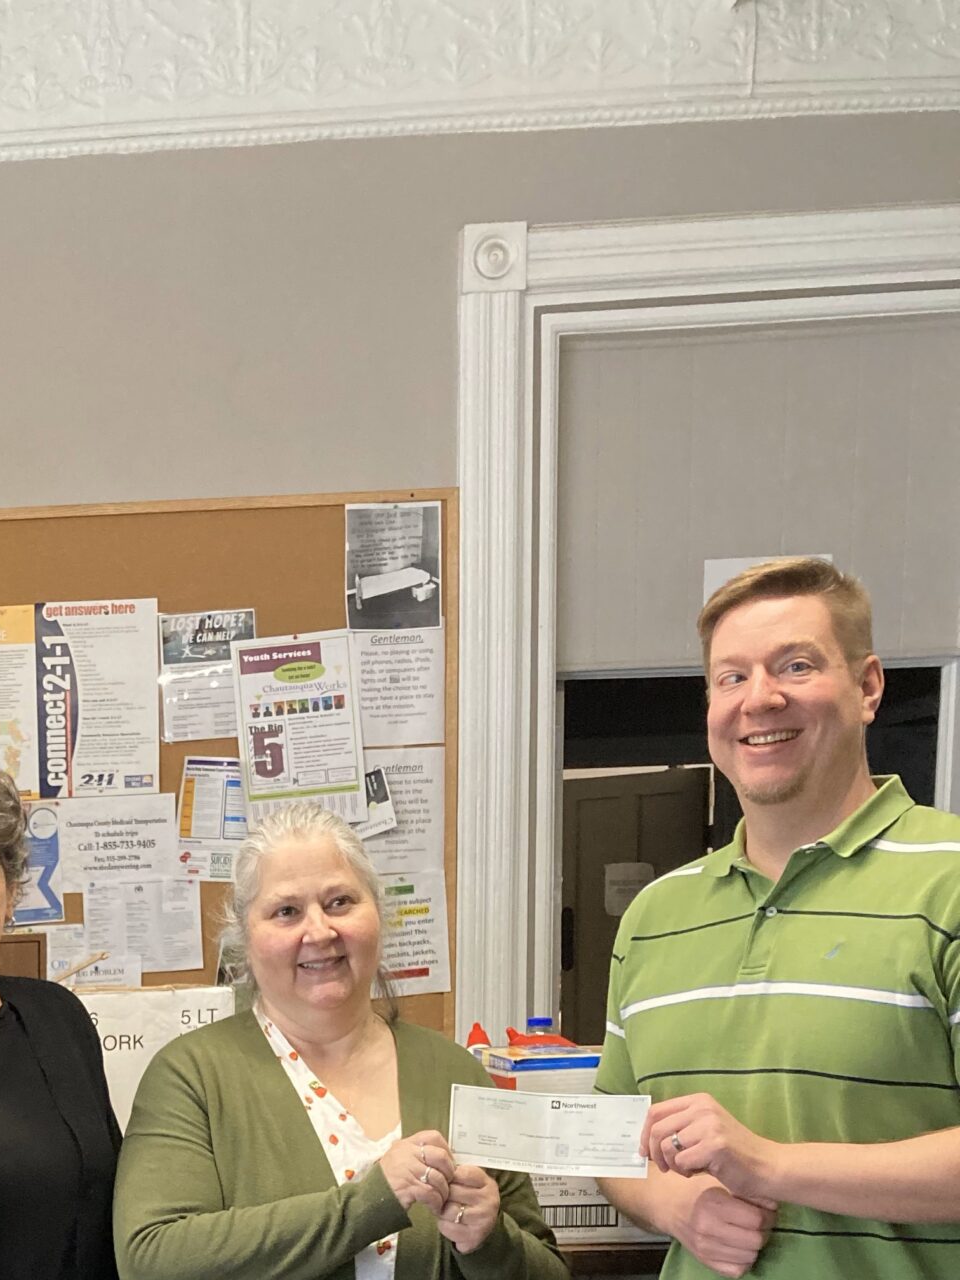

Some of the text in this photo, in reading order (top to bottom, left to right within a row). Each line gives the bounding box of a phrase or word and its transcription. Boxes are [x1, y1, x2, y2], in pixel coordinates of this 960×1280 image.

[45, 603, 136, 618] get answers here
[170, 613, 246, 632] LOST HOPE?
[196, 632, 214, 643] CAN
[242, 649, 312, 663] Youth Services
[248, 723, 283, 735] The Big
[252, 731, 285, 778] 5
[408, 897, 432, 905] subject
[89, 968, 125, 978] PROBLEM
[180, 1009, 191, 1025] 5
[198, 1008, 218, 1024] LT
[103, 1034, 144, 1051] ORK
[562, 1101, 597, 1110] Northwest
[559, 1189, 569, 1197] 20
[578, 1189, 587, 1197] 75
